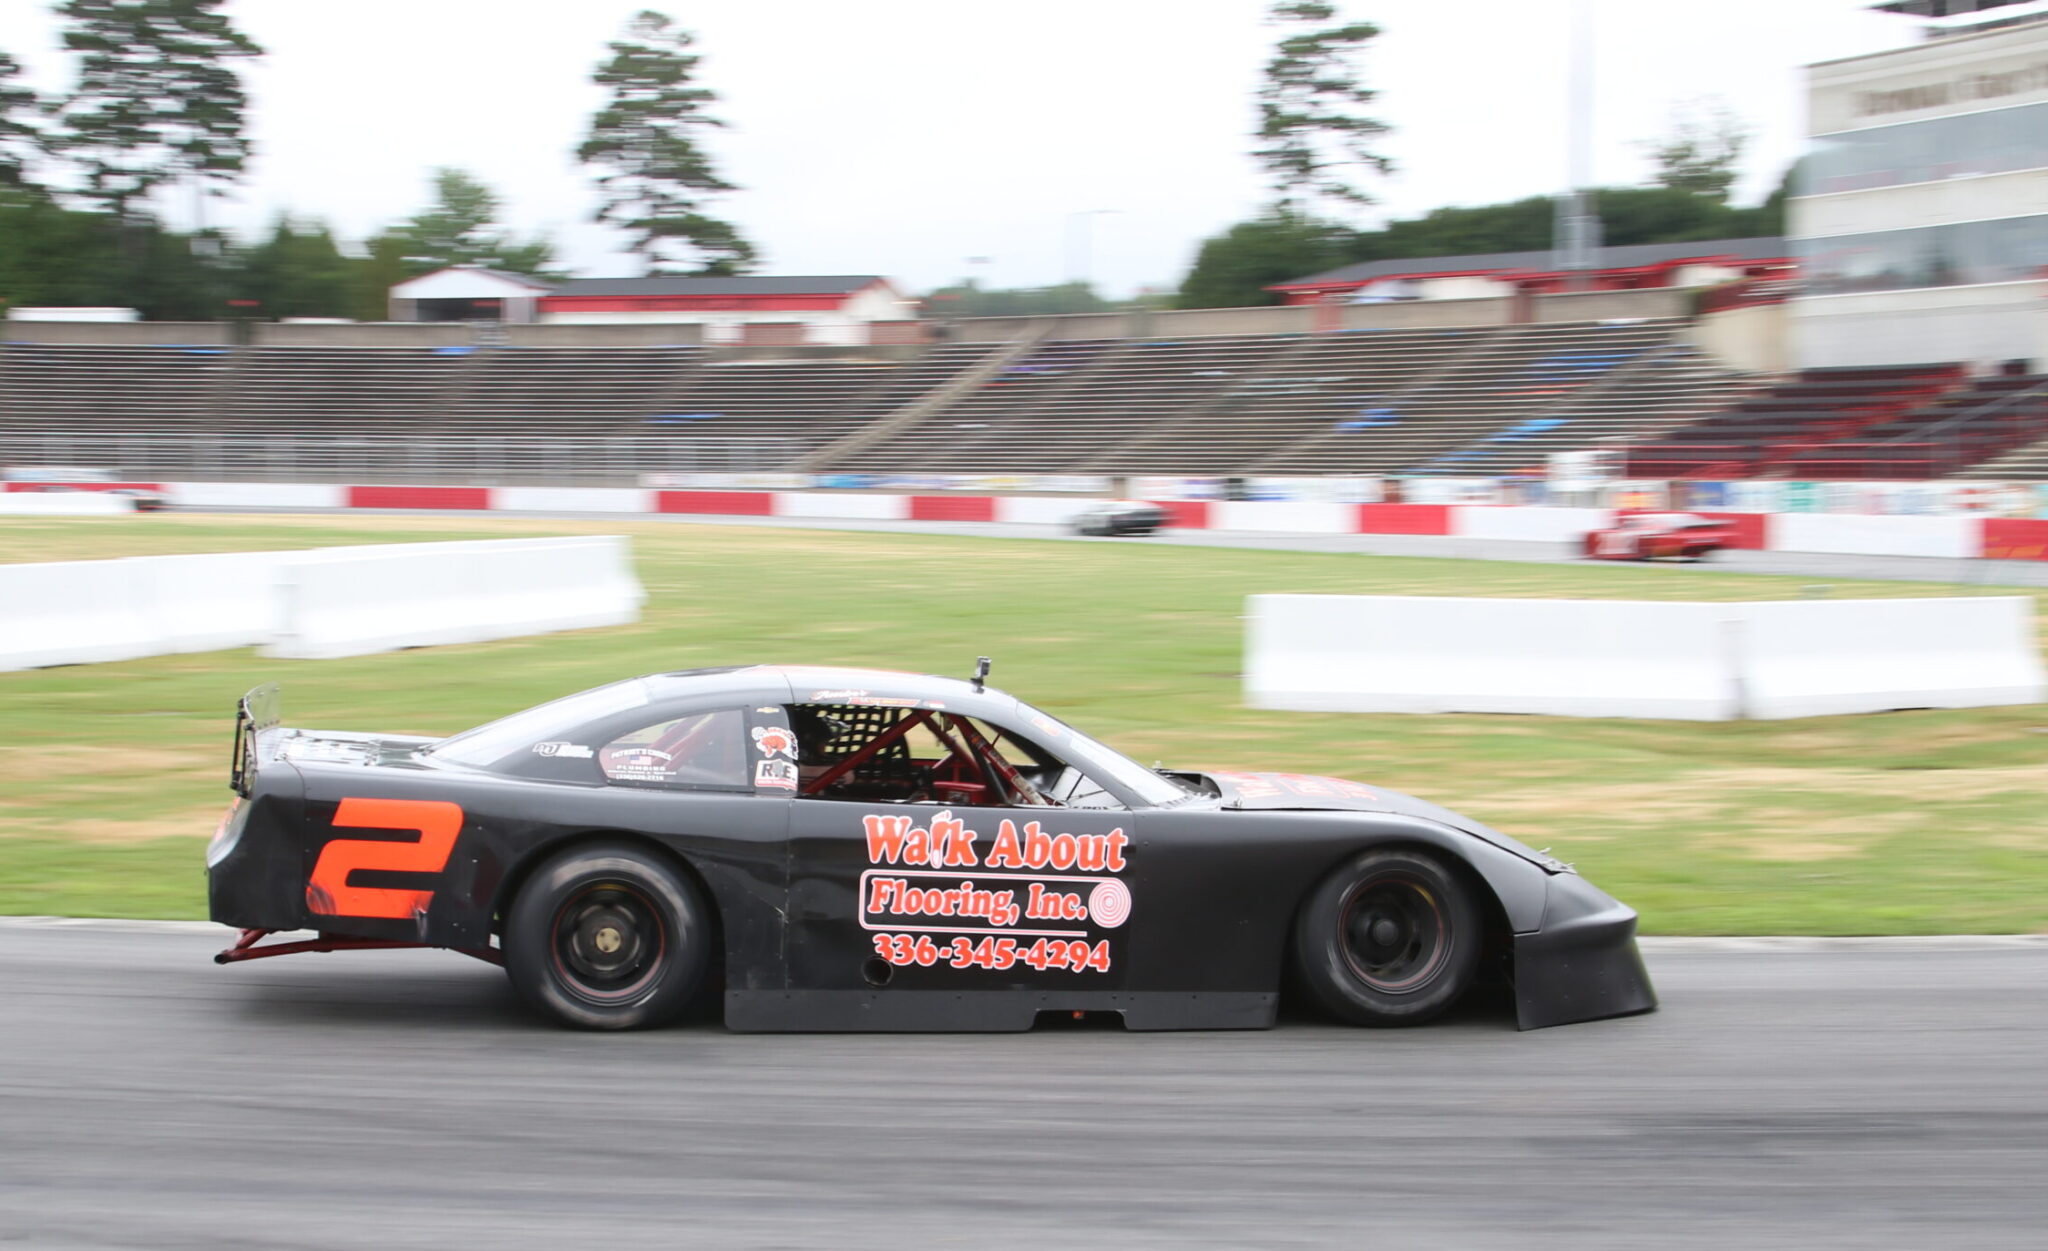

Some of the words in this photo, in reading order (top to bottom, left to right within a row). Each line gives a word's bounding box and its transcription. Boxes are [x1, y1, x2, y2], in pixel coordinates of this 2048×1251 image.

[306, 797, 464, 919] 2
[863, 810, 978, 868] Walk
[985, 819, 1128, 872] About
[867, 878, 1020, 926] Flooring,
[1025, 883, 1088, 921] Inc.
[872, 933, 1111, 973] 336-345-4294
